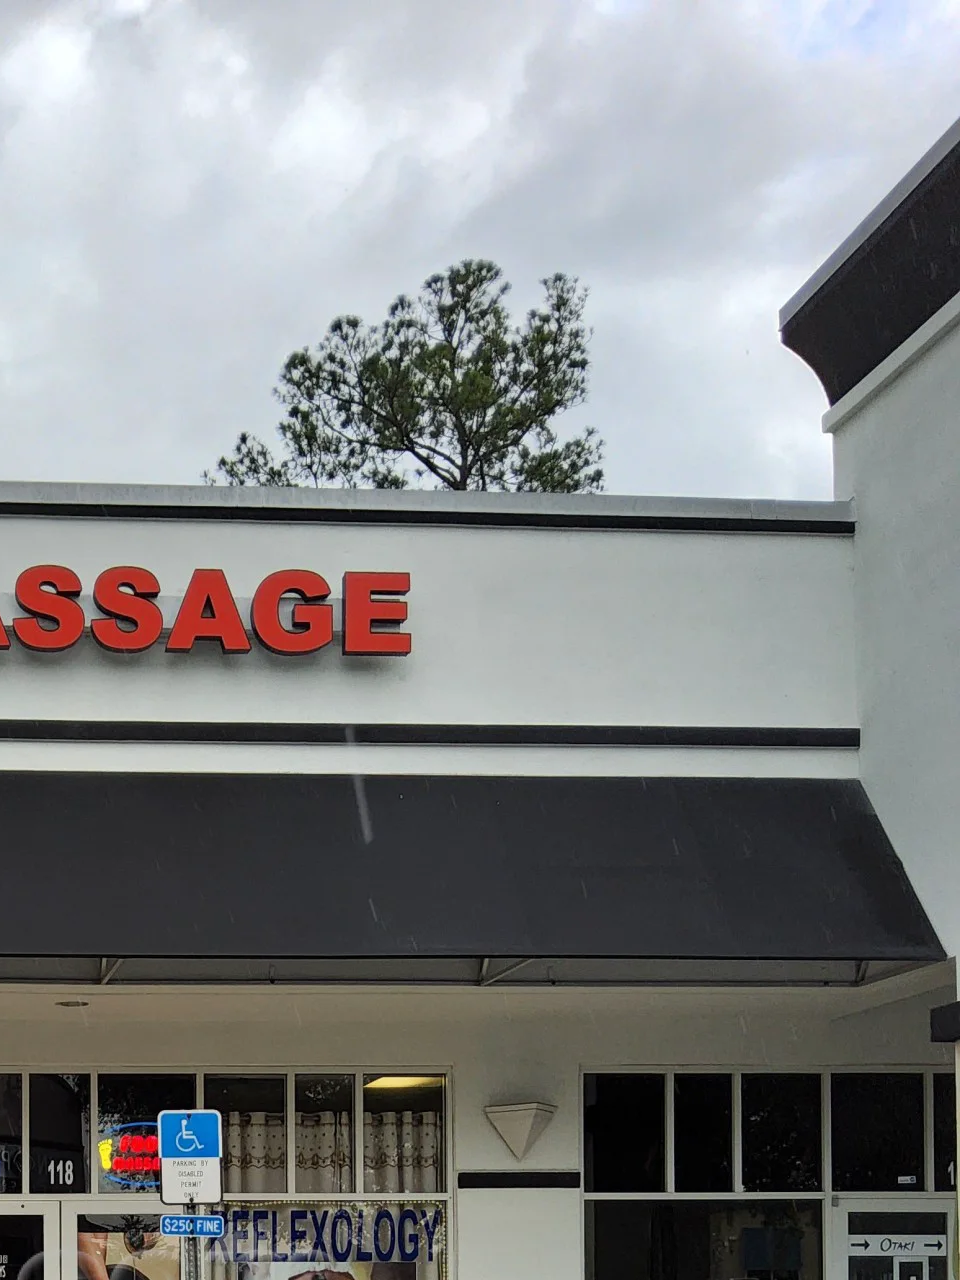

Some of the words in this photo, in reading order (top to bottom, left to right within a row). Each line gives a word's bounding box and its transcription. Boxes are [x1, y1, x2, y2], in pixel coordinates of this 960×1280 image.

[119, 1135, 158, 1153] FOO
[47, 1160, 74, 1185] 118
[178, 1170, 204, 1178] DISABLED
[184, 1191, 199, 1199] ONLY
[163, 1218, 193, 1233] $250
[196, 1220, 220, 1232] FINE
